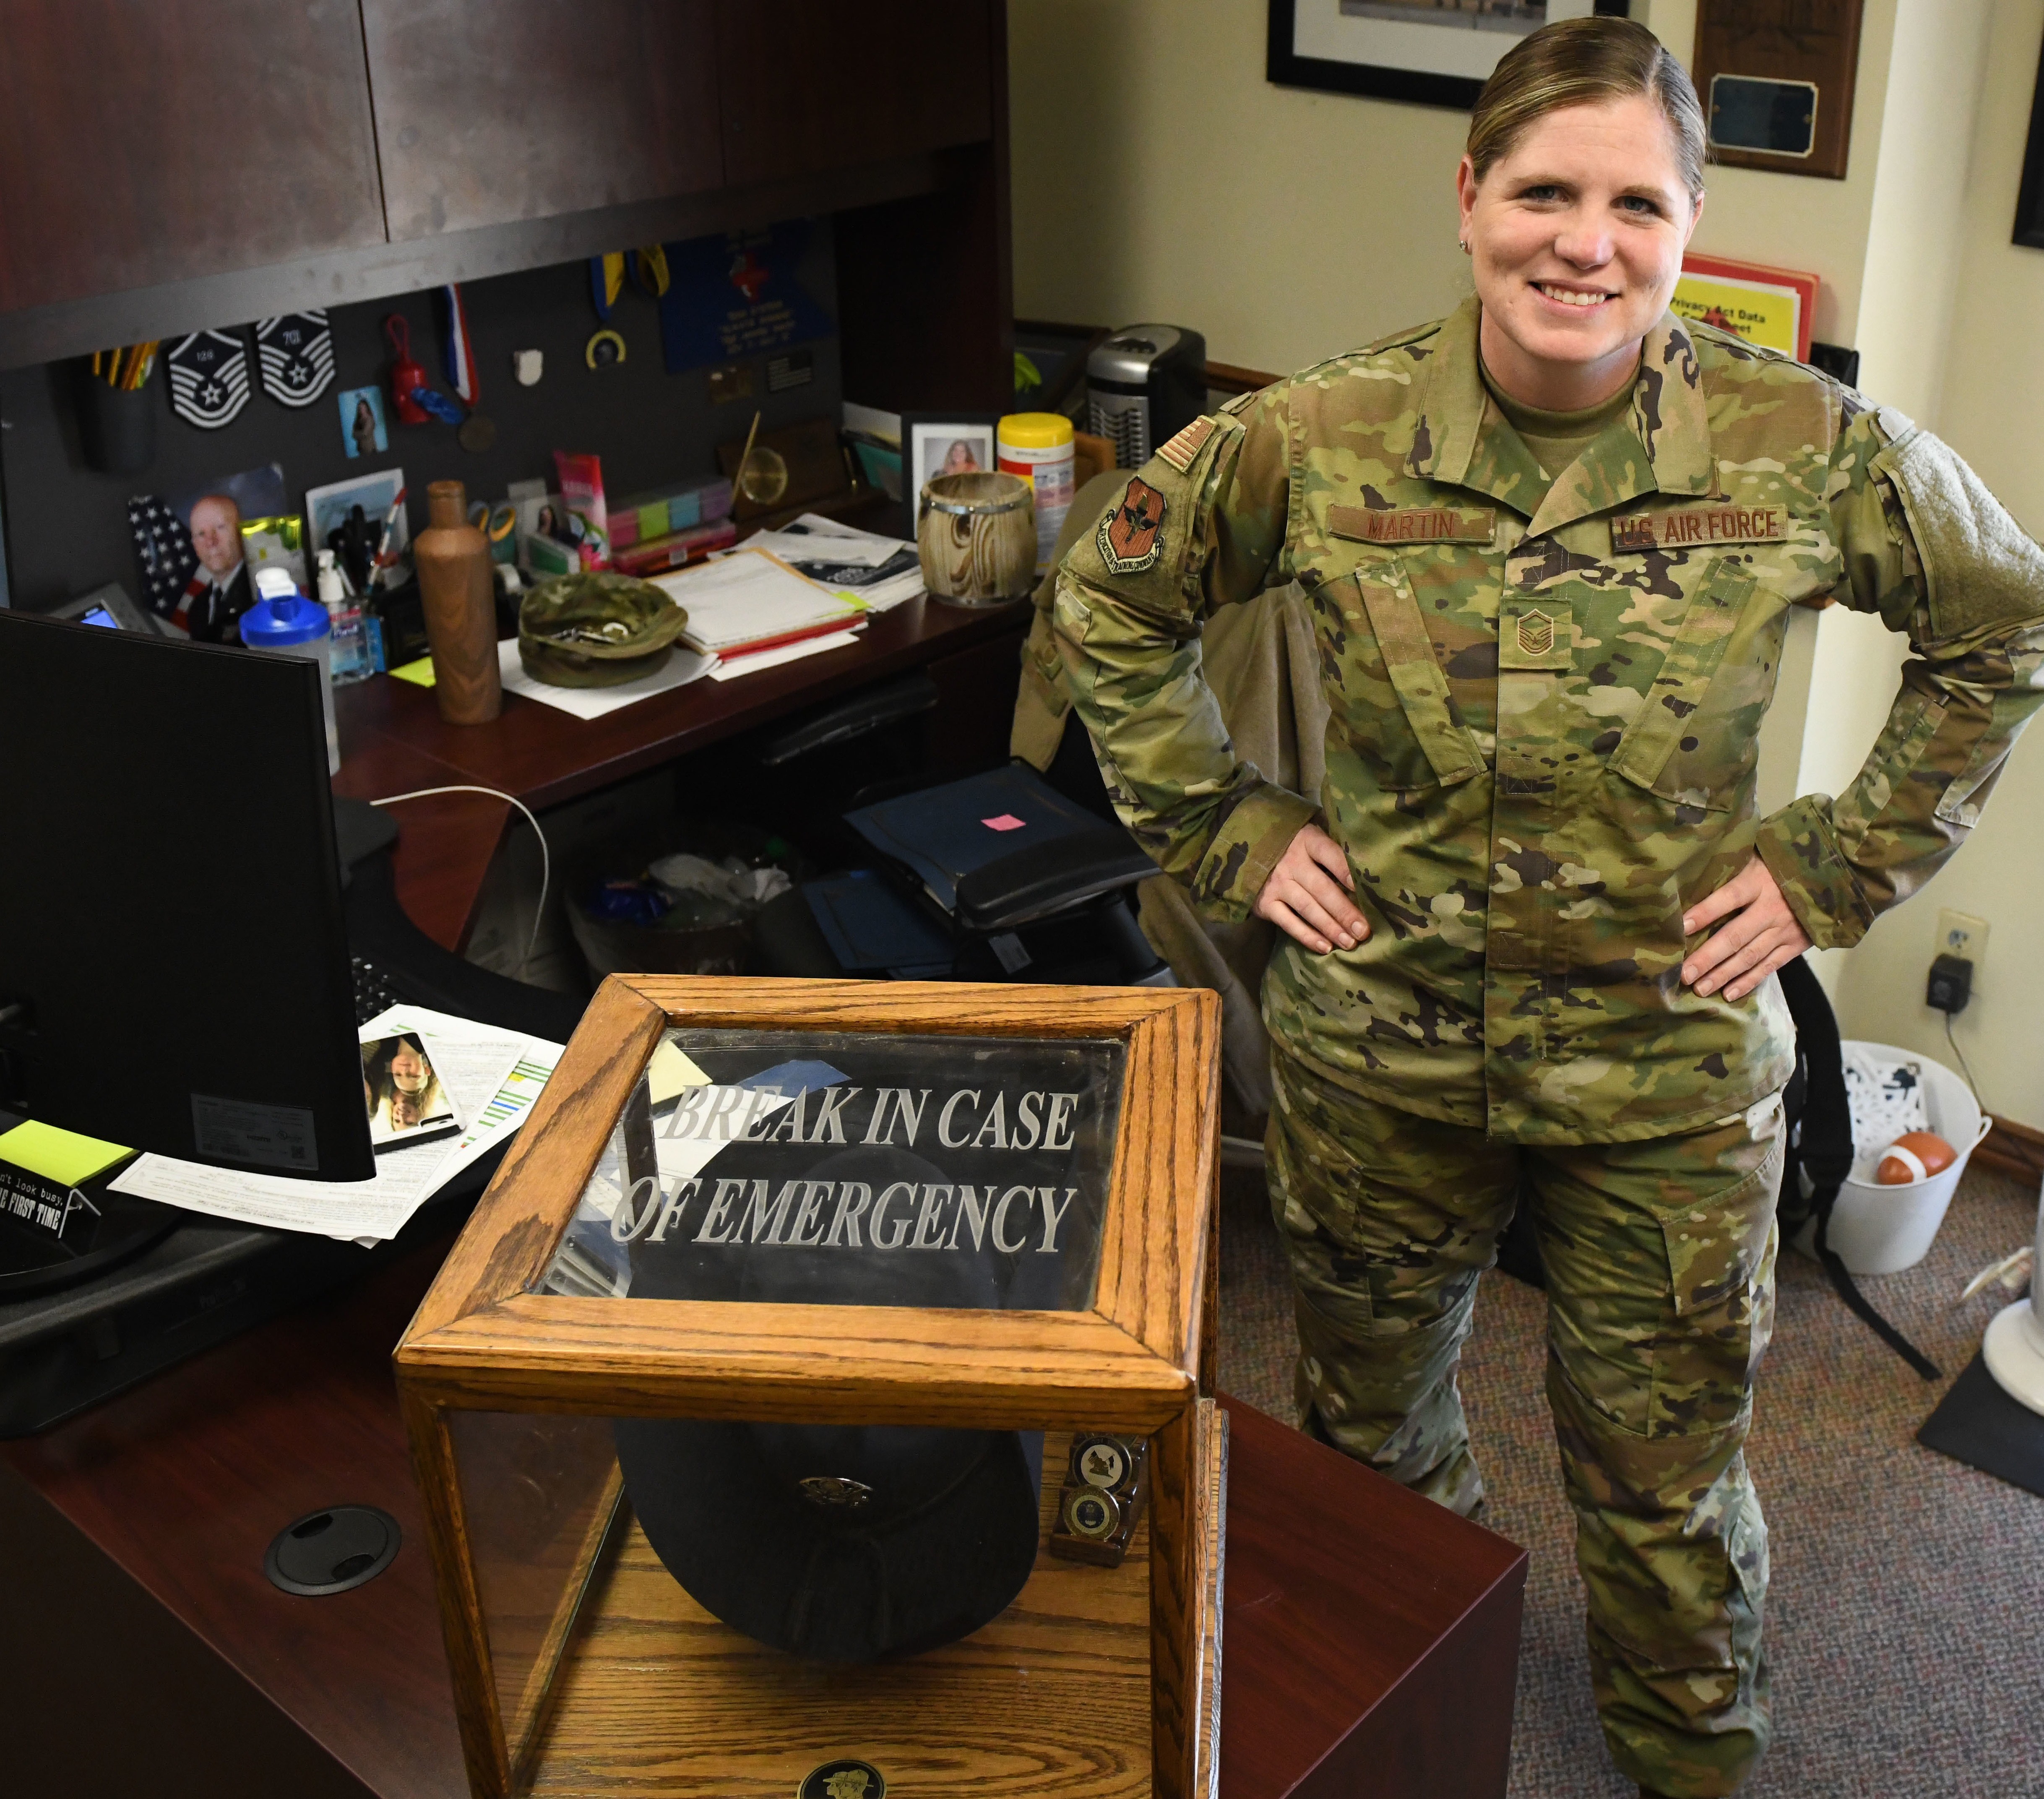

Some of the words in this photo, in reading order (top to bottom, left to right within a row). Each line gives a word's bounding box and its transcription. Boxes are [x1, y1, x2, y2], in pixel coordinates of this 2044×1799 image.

[1738, 309, 1765, 323] Data
[1367, 512, 1455, 540] MARTIN
[1621, 518, 1653, 545] US
[1665, 515, 1703, 543] AIR
[1708, 510, 1778, 540] FORCE
[1112, 561, 1134, 572] TRAINING
[659, 1085, 862, 1144] BREAK
[859, 1088, 932, 1147] IN
[938, 1089, 1079, 1151] CASE
[16, 1178, 37, 1195] look
[41, 1188, 63, 1206] busy,
[8, 1192, 36, 1219] FIRST
[36, 1203, 61, 1230] TIME
[611, 1176, 703, 1243] OF
[691, 1178, 1078, 1253] EMERGENCY
